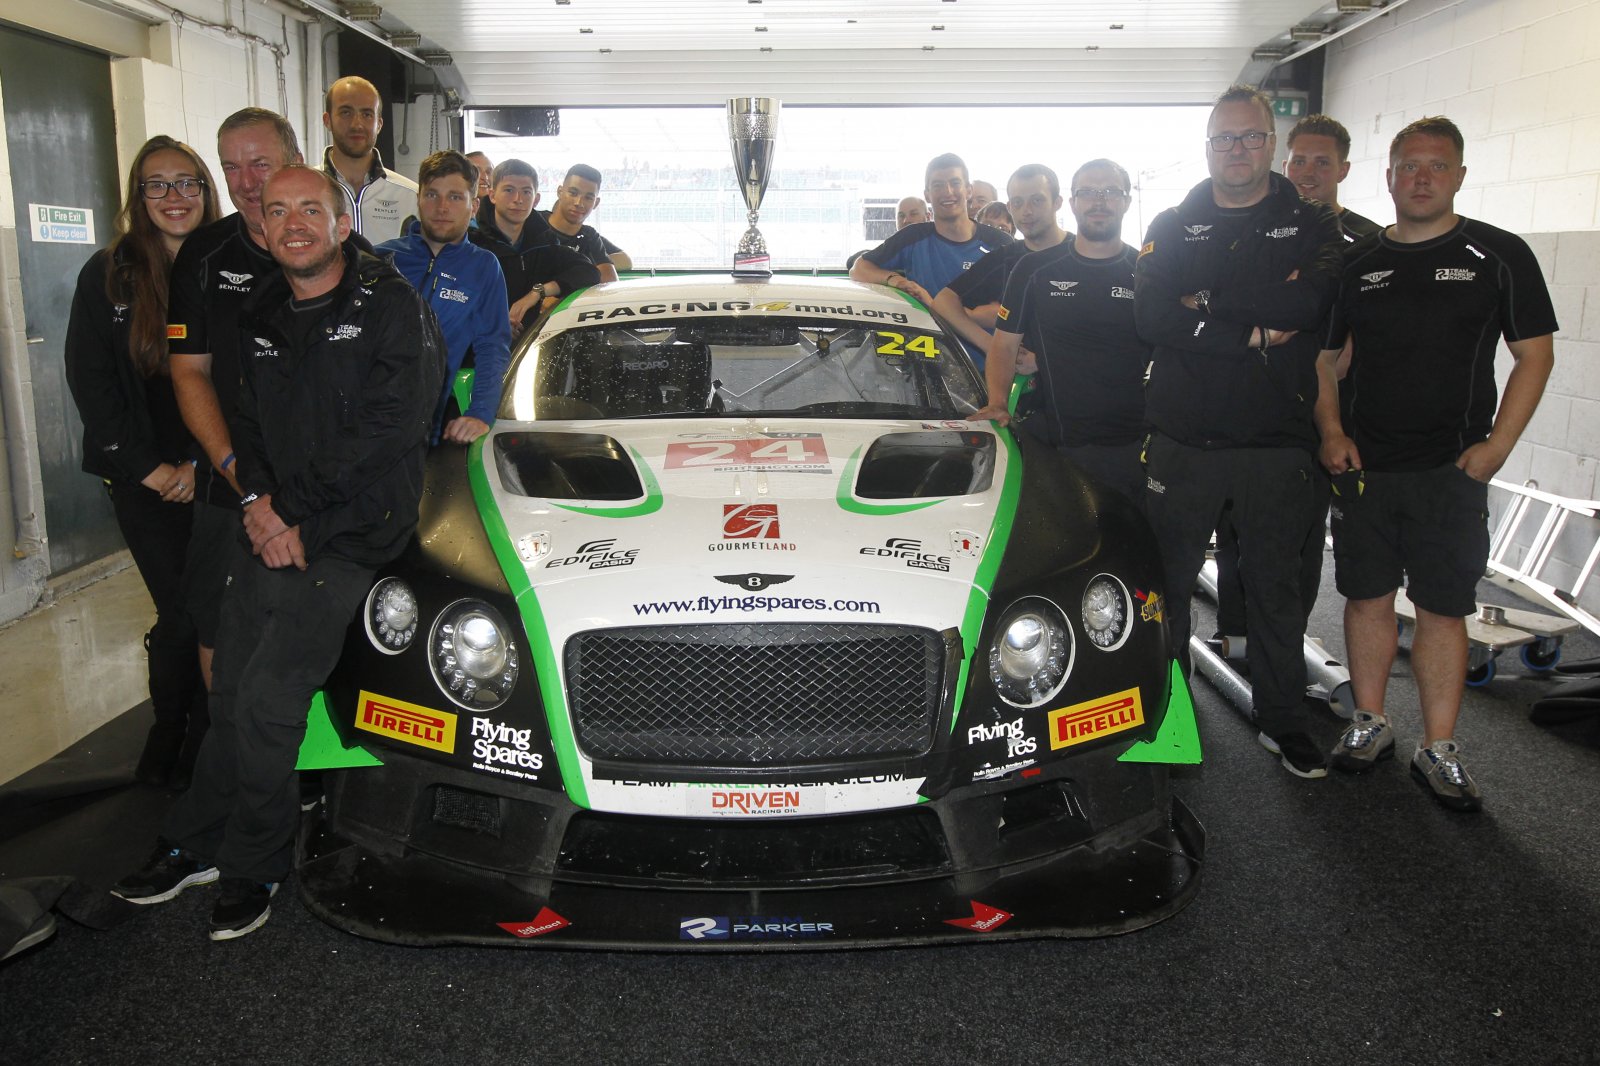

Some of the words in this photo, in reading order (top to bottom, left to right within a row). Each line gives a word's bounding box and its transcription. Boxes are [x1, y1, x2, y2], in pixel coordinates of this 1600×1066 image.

[54, 210, 68, 221] Fire
[69, 212, 82, 223] Exit
[52, 227, 69, 239] Keep
[70, 228, 86, 239] clear
[219, 283, 251, 292] BENTLEY
[1360, 282, 1390, 291] BENTLEY
[877, 331, 940, 358] 24
[622, 360, 669, 370] RECARO
[683, 440, 815, 465] 24
[708, 541, 796, 552] GOURMETLAND
[545, 548, 640, 568] EDIFICE
[591, 558, 633, 568] CASIO
[860, 547, 951, 565] EDIFICE
[908, 560, 948, 571] CASIO
[633, 595, 881, 616] www.flyingspares.com
[363, 699, 445, 743] PIRELLI
[1057, 696, 1136, 742] PIRELLI
[471, 716, 532, 751] Flying
[472, 738, 543, 770] Spares
[712, 791, 800, 814] DRIVEN
[522, 920, 562, 935] contact
[733, 922, 834, 933] PARKER
